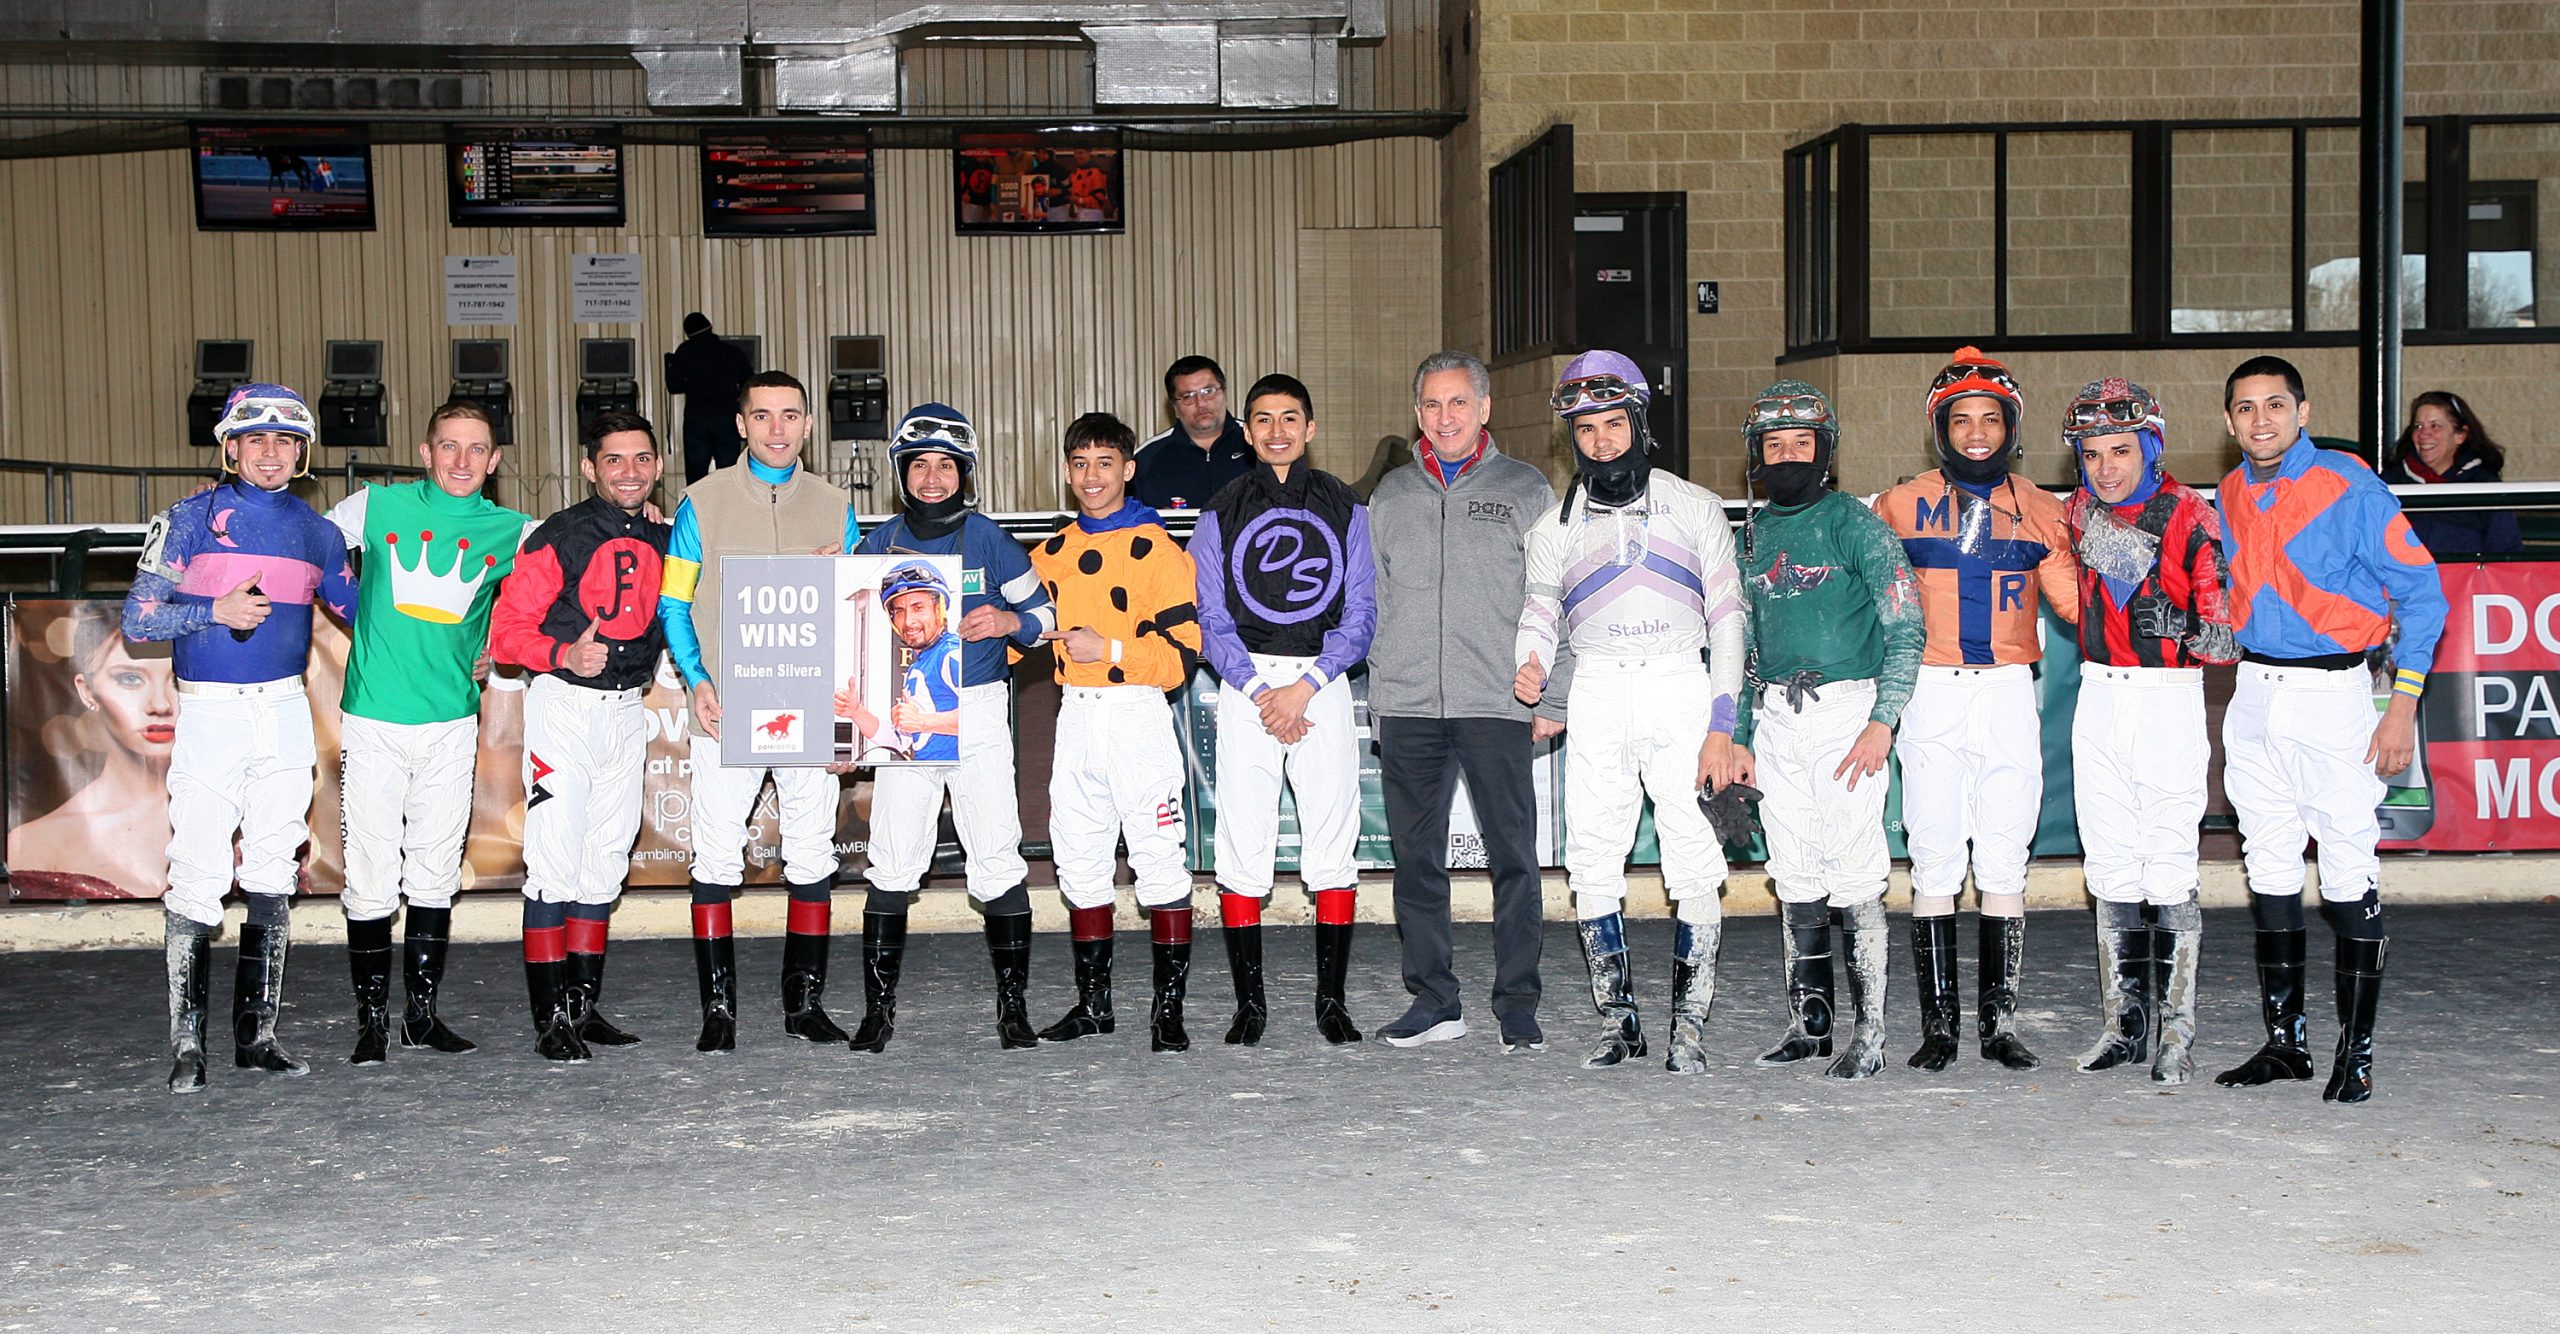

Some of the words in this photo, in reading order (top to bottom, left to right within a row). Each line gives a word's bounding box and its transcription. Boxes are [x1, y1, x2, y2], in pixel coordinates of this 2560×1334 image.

[716, 174, 724, 184] 5
[717, 199, 725, 208] 2
[584, 299, 631, 307] 717-787-1942
[1915, 496, 1951, 532] M
[737, 585, 820, 615] 1000
[1998, 575, 2026, 612] R
[739, 623, 818, 648] WINS
[1607, 619, 1671, 638] Stable
[734, 664, 774, 678] Ruben
[777, 663, 822, 678] Silvera
[648, 755, 674, 775] at
[752, 845, 777, 858] Call
